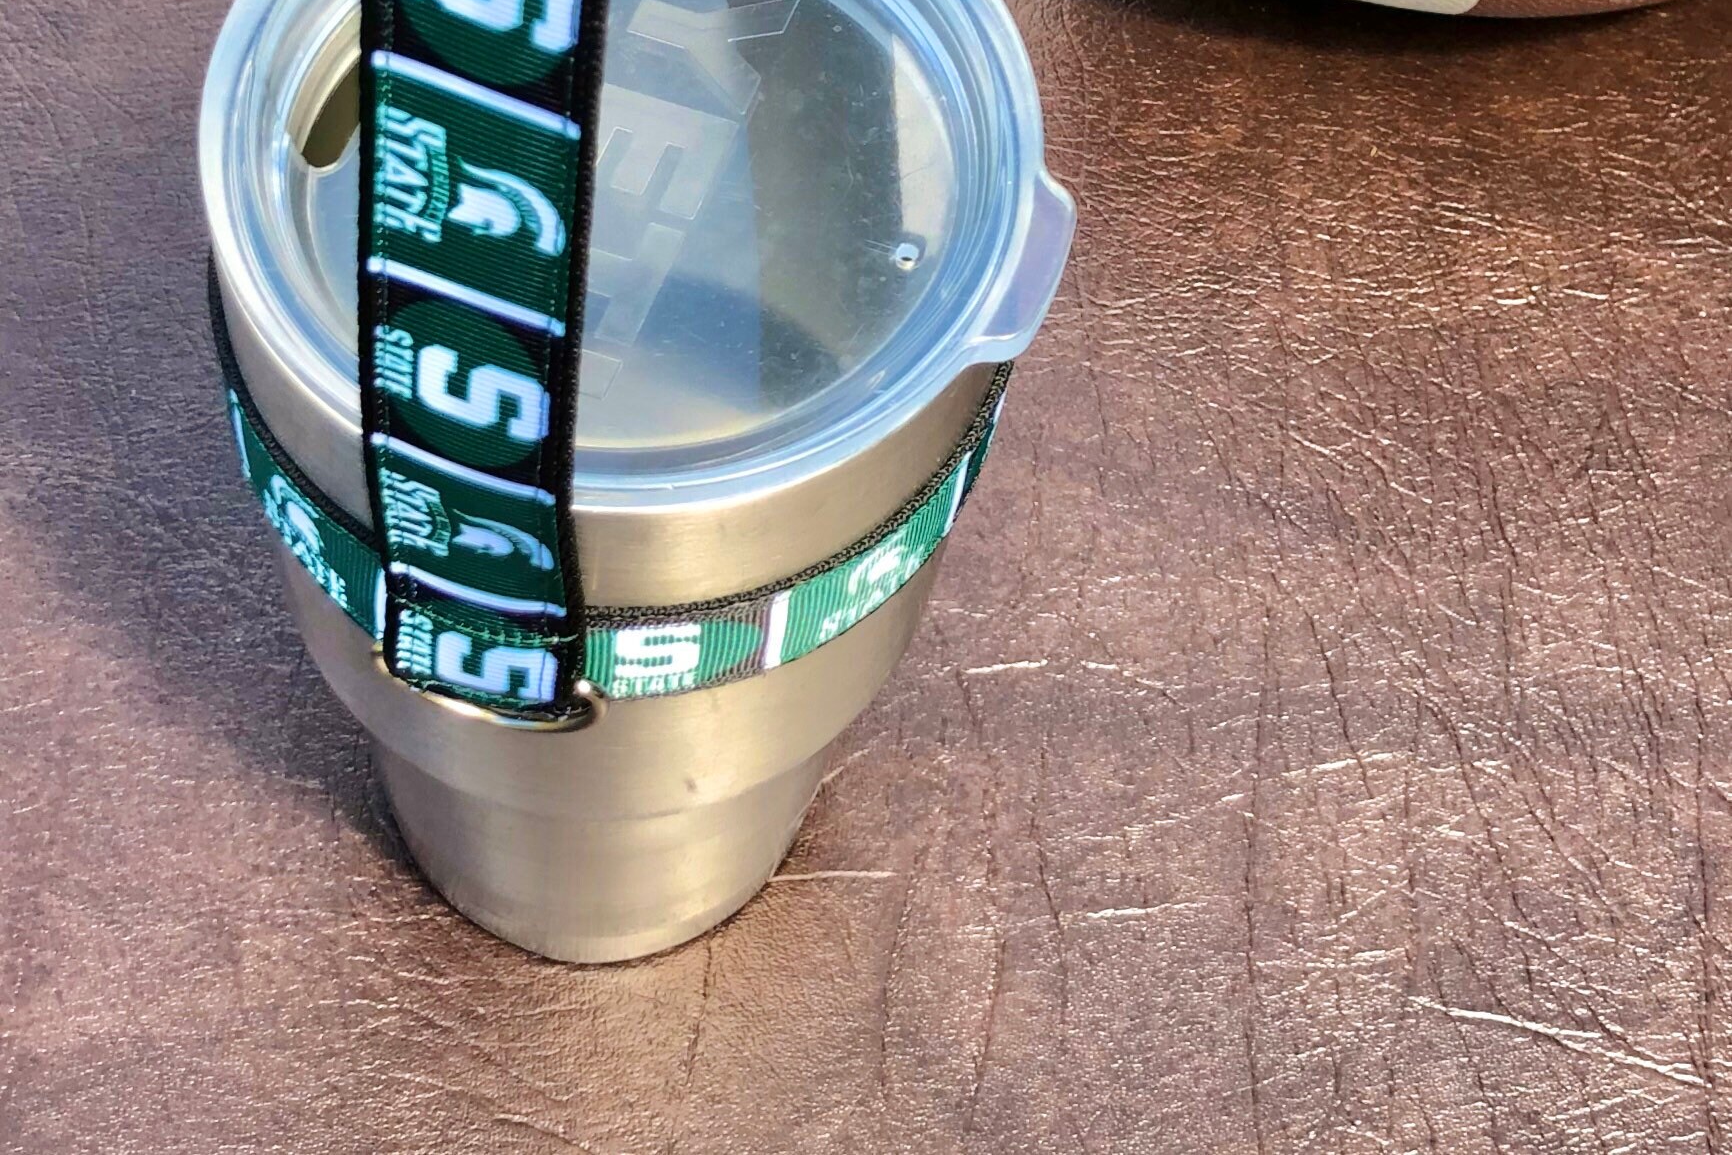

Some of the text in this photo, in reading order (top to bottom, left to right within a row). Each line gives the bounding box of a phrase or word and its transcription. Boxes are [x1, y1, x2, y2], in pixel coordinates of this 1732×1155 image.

[374, 104, 447, 242] STATE
[374, 325, 413, 400] STATE
[417, 344, 550, 442] S
[379, 467, 449, 557] STATE
[436, 631, 557, 703] S
